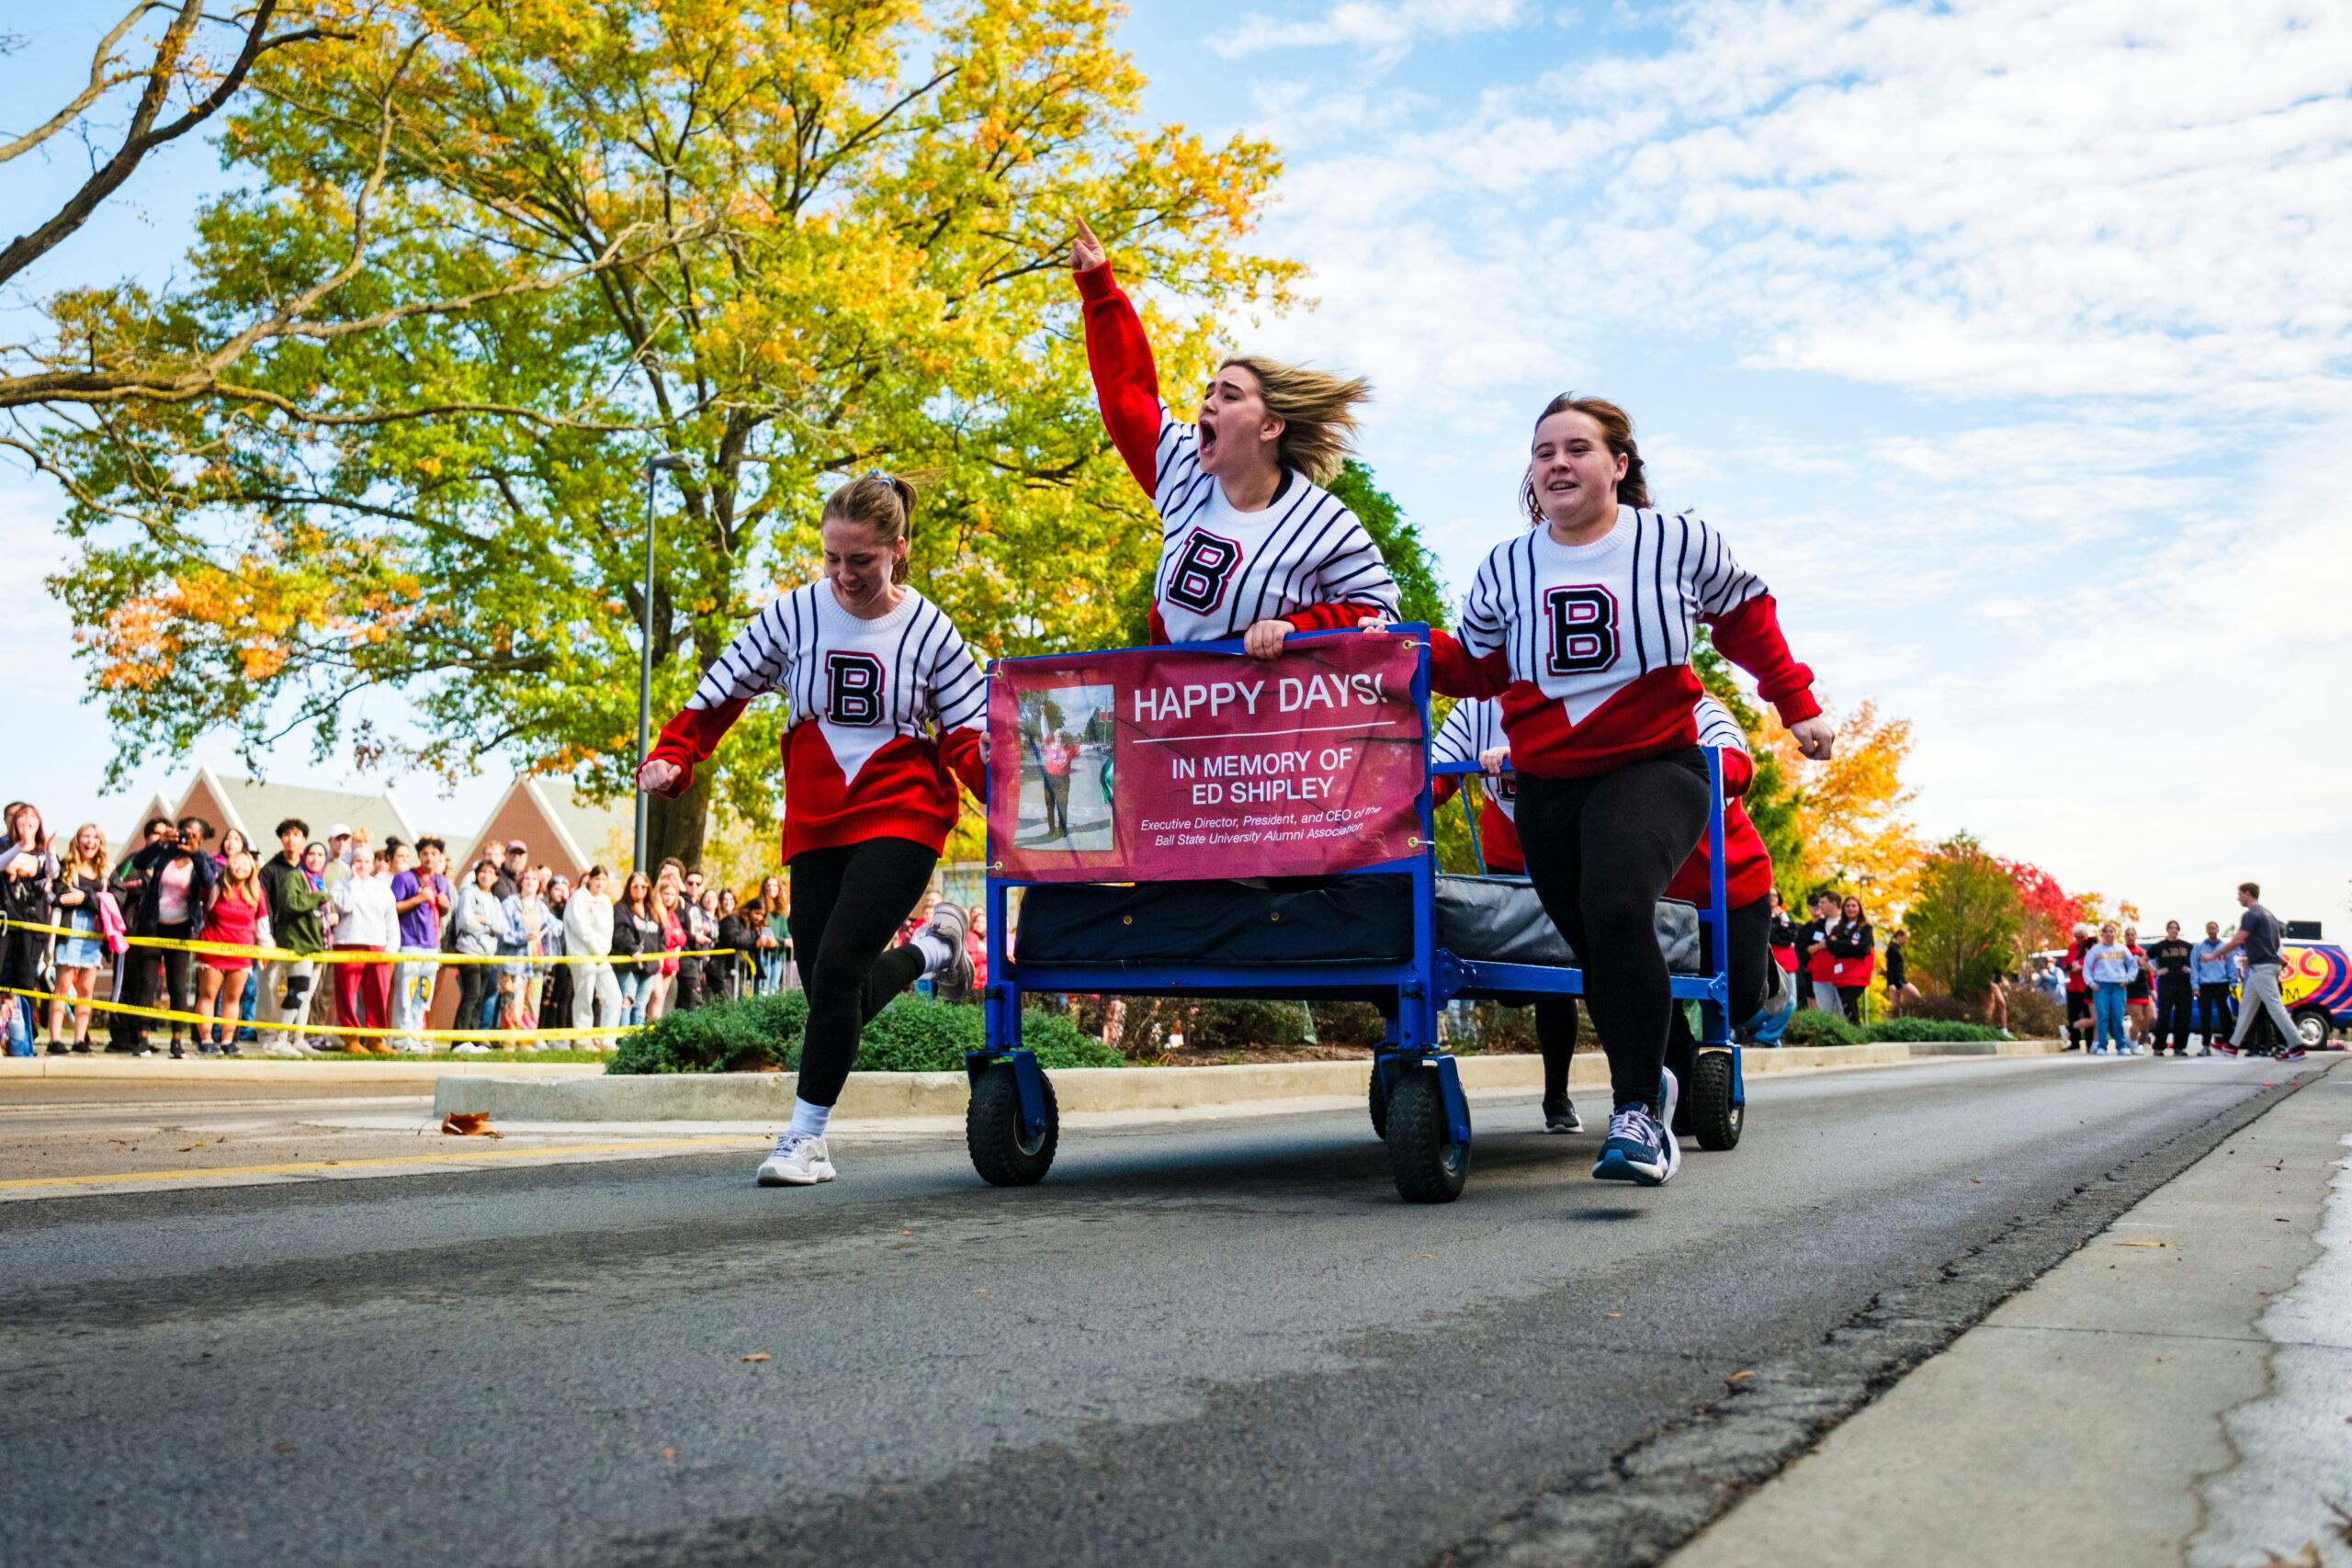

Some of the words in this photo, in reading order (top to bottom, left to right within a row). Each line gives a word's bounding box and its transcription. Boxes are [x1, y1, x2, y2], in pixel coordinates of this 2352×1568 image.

[1166, 526, 1243, 617] B
[1544, 583, 1621, 677] B
[824, 650, 886, 728] B
[1135, 681, 1264, 722] HAPPY
[1280, 673, 1387, 712] DAYS!
[1173, 758, 1194, 778] IN
[1204, 750, 1311, 777] MEMORY
[1319, 748, 1352, 771] OF
[1193, 784, 1222, 805] ED
[1230, 776, 1334, 803] SHIPLEY
[1141, 818, 1191, 830] Executive
[1194, 818, 1238, 829] Director,
[1243, 814, 1296, 828] President,
[1301, 812, 1323, 823] and
[1326, 809, 1351, 821] CEO
[1354, 807, 1365, 818] of
[1365, 807, 1382, 815] the
[1155, 835, 1174, 845] Ball
[1178, 834, 1205, 845] State
[1209, 831, 1261, 843] University
[1263, 829, 1304, 840] Alumni
[1306, 823, 1363, 839] Association
